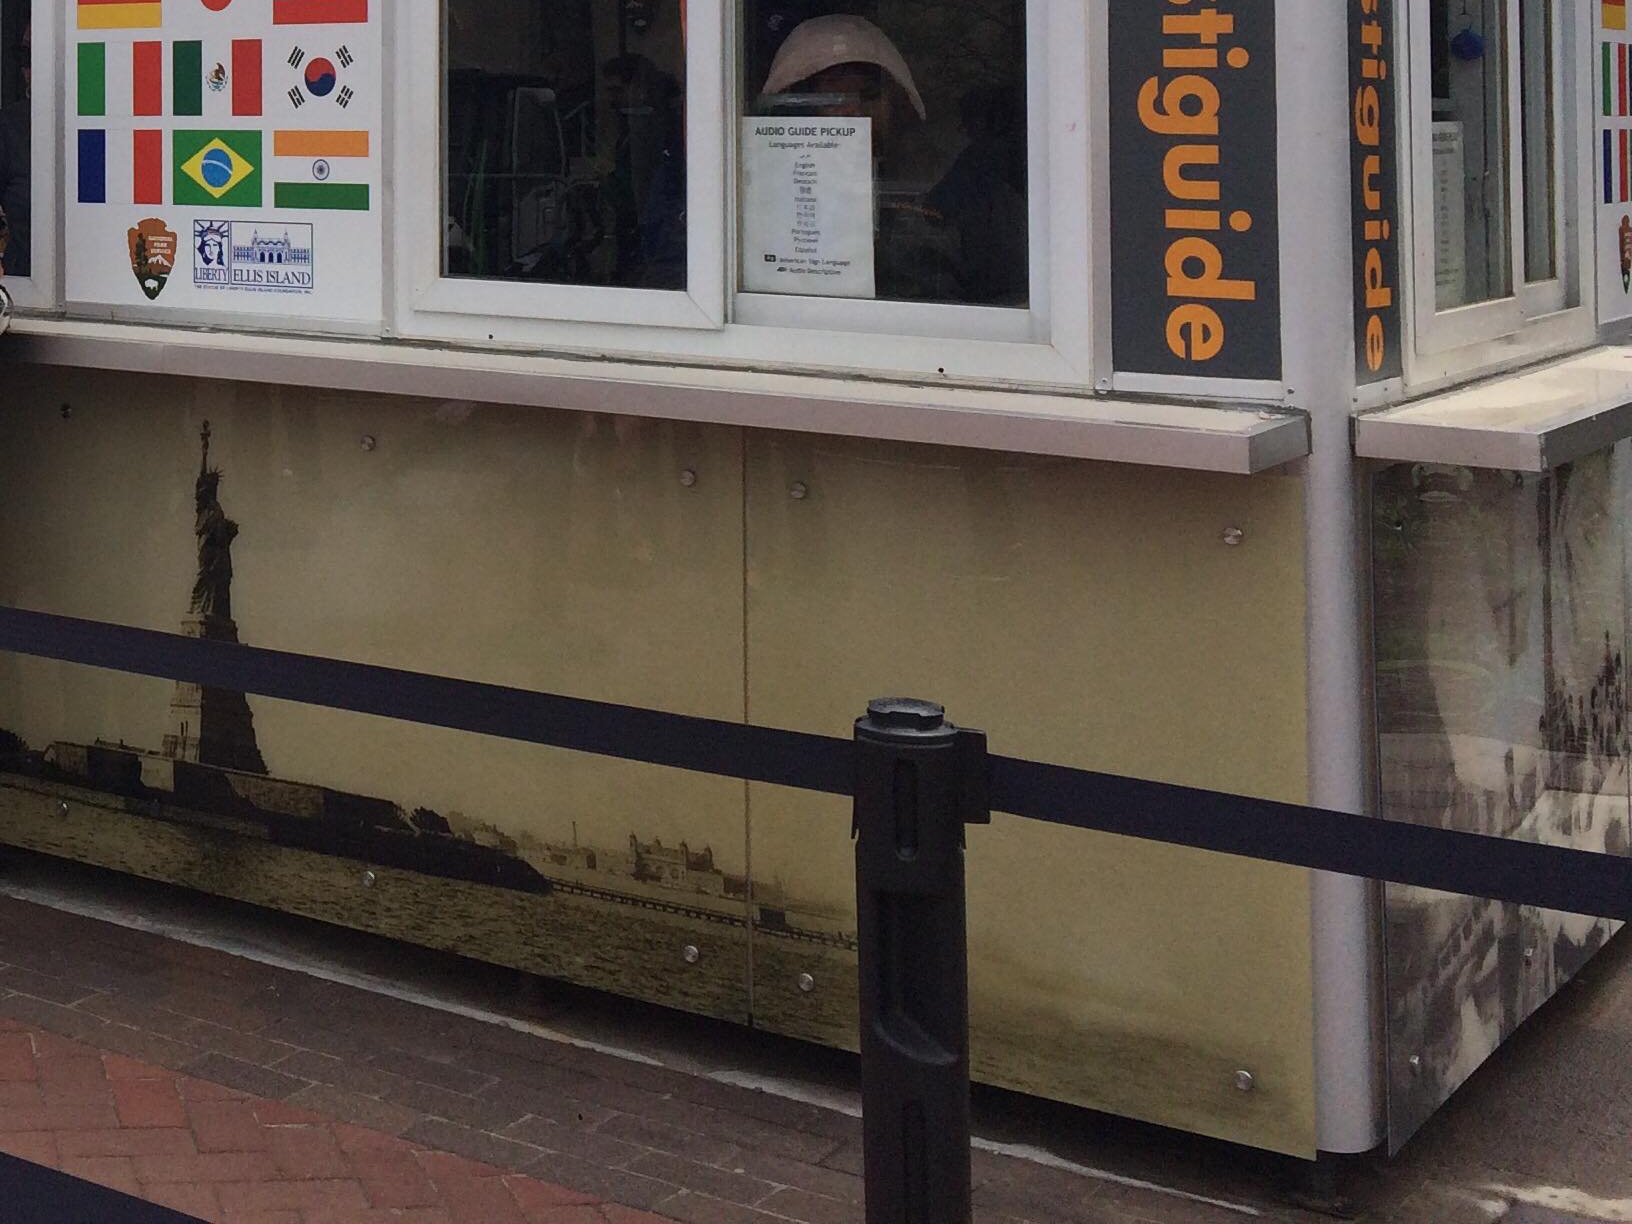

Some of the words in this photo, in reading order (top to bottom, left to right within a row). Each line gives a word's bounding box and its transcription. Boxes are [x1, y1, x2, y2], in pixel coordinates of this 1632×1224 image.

[755, 127, 785, 136] AUDIO
[788, 127, 817, 136] GUIDE
[820, 127, 856, 137] PICKUP
[194, 267, 228, 281] LIBERTY
[233, 268, 263, 283] ELLIS
[266, 270, 311, 285] ISLAND
